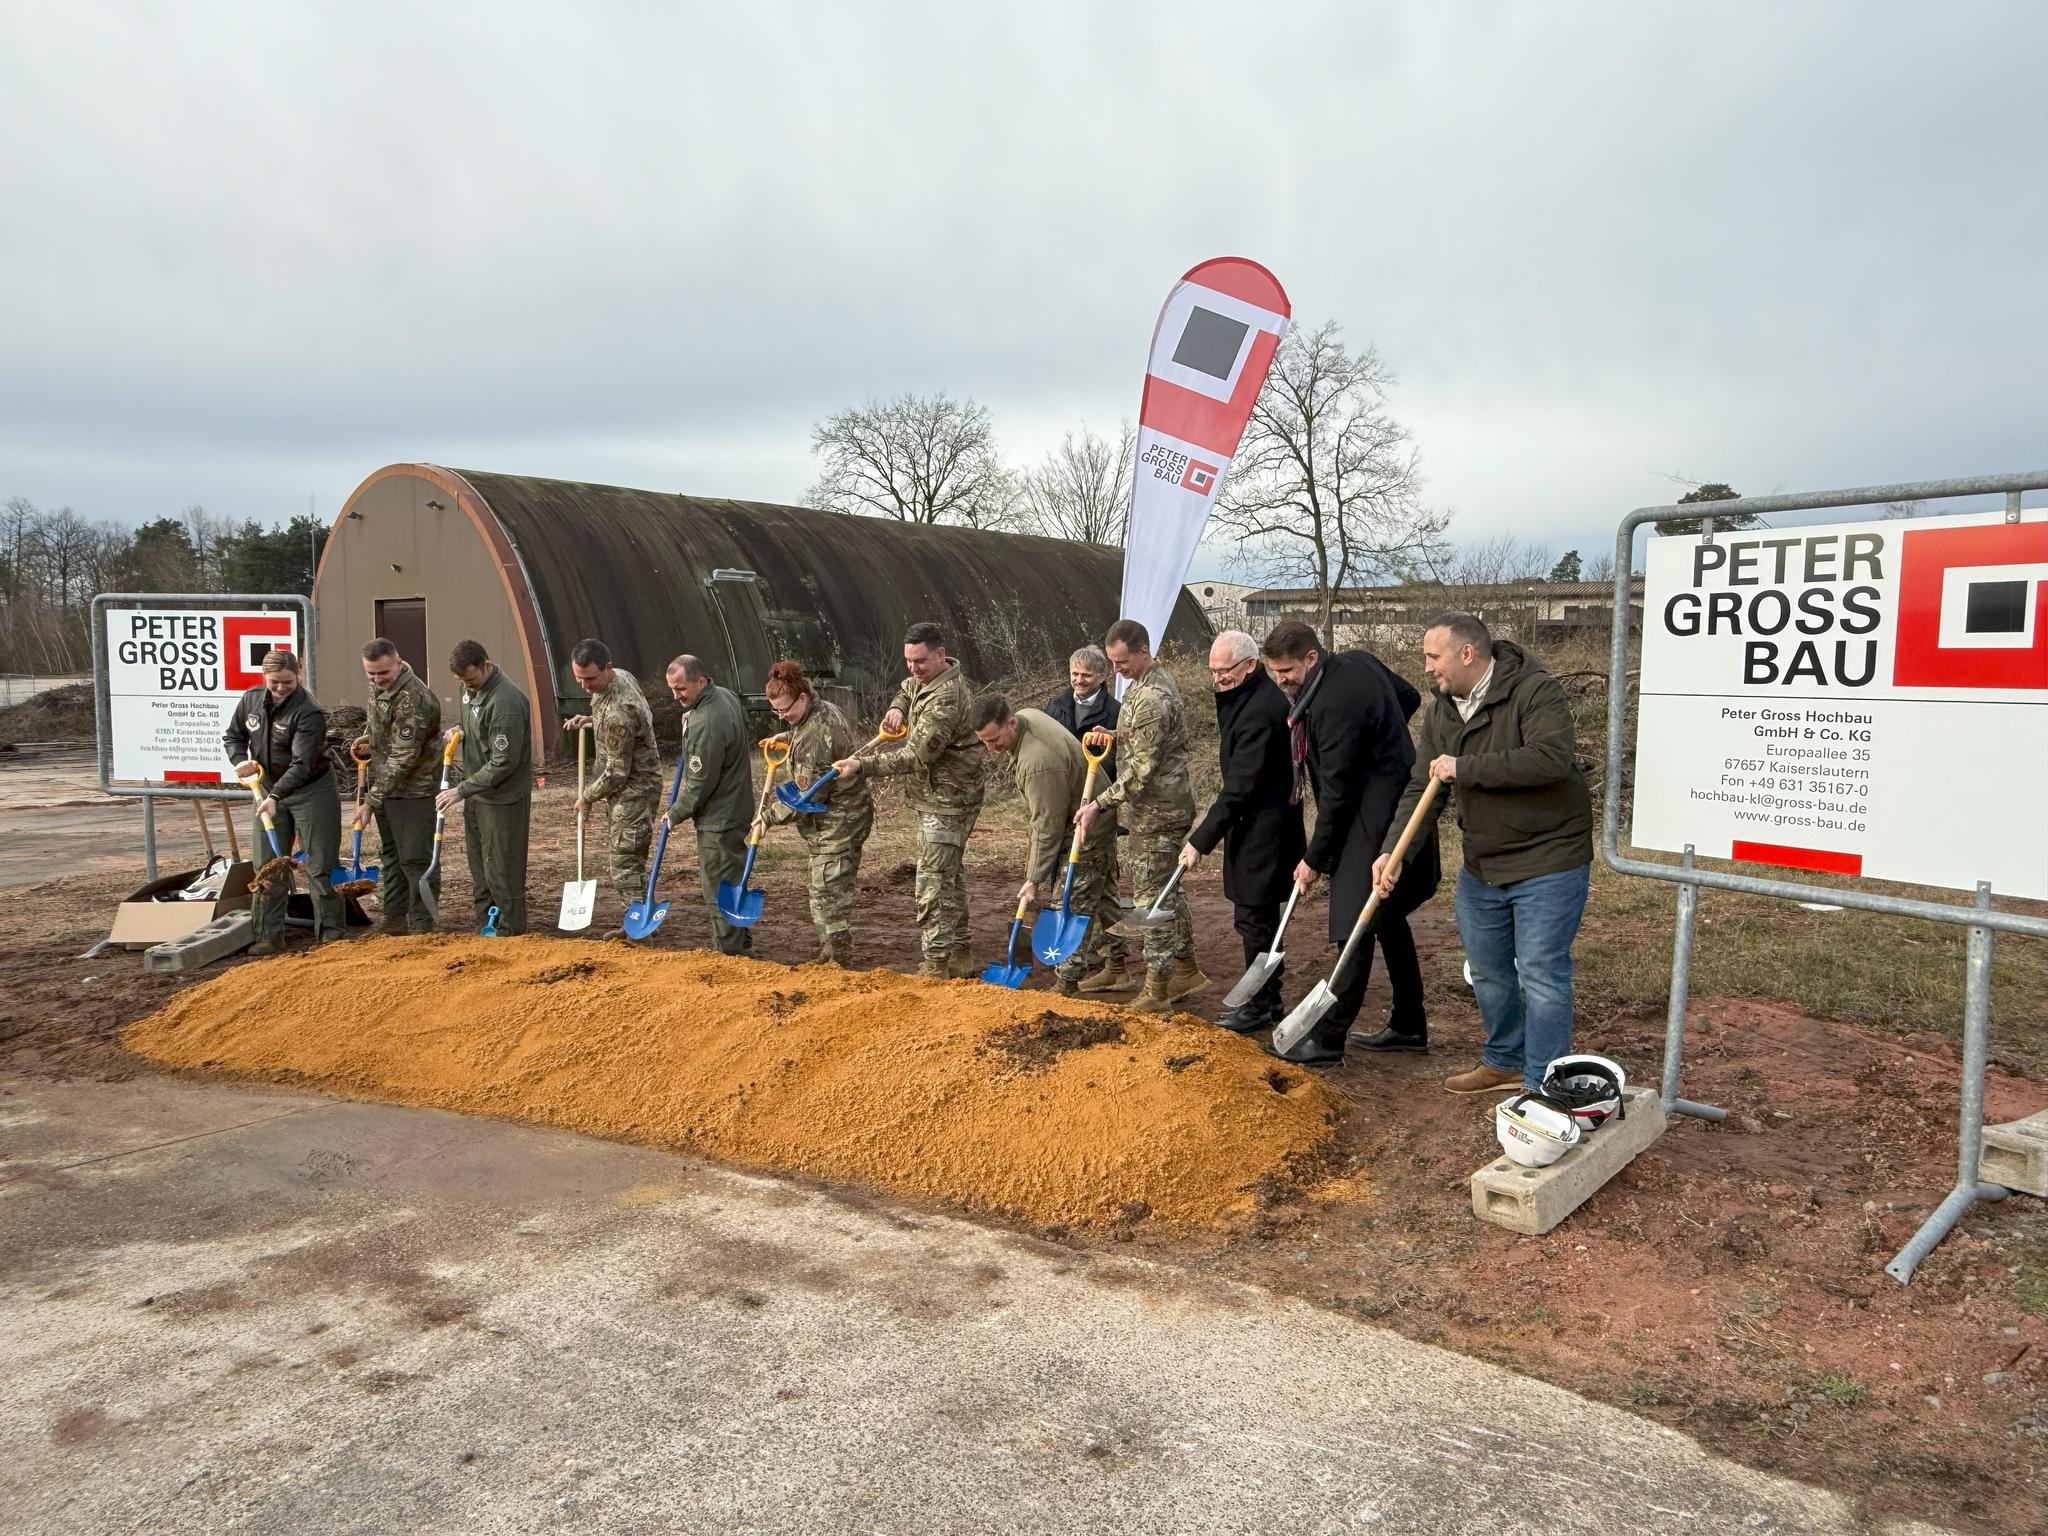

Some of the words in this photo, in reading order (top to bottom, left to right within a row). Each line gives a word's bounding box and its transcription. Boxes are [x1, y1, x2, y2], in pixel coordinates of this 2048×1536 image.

[1141, 452, 1184, 475] GROSS
[1149, 443, 1189, 466] PETER
[1153, 468, 1181, 485] BAU
[1692, 533, 1884, 588] PETER
[1663, 585, 1881, 637] GROSS
[131, 615, 218, 640] PETER
[118, 641, 219, 666] GROSS
[1743, 640, 1878, 687] BAU
[160, 667, 219, 691] BAU
[1721, 707, 1757, 720] Peter
[1760, 708, 1801, 721] Gross
[1805, 710, 1873, 724] Hochbau
[1753, 725, 1798, 739] GmbH
[1803, 727, 1816, 739] &
[1820, 728, 1844, 741] Co.
[1849, 729, 1872, 742] KG
[1766, 744, 1848, 760] Europaallee
[1852, 749, 1871, 761] 35
[1724, 758, 1765, 772] 67657
[1769, 761, 1869, 780] Kaiserslautern
[1721, 774, 1745, 788] Fon
[1749, 777, 1775, 789] +49
[1779, 779, 1803, 792] 631
[1808, 780, 1868, 797] 35167-0
[1690, 788, 1867, 814] hochbau-kl@gross-bau.de
[1733, 810, 1866, 832] www.gross-bau.de
